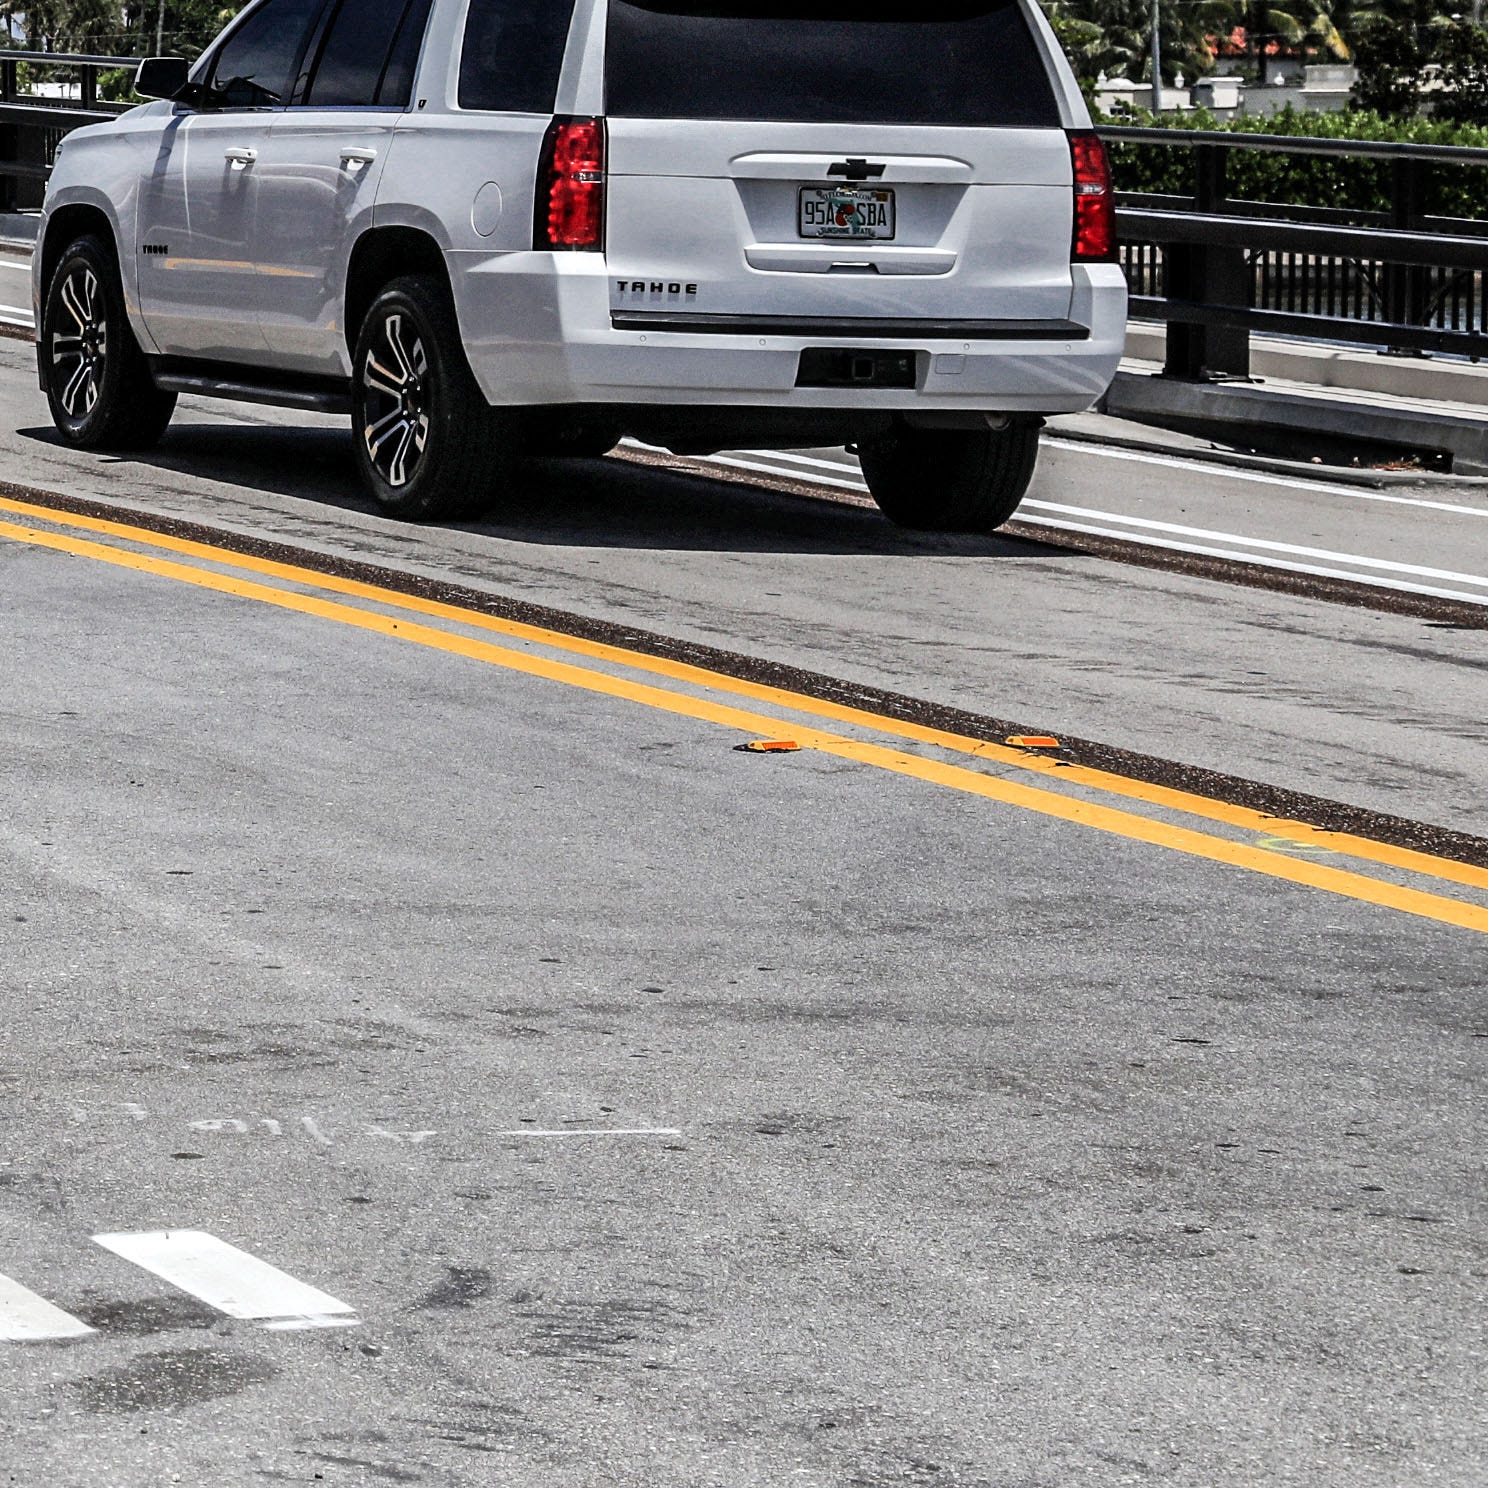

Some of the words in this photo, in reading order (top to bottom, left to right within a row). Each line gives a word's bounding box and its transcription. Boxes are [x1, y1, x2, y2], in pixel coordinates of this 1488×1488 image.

[805, 201, 835, 225] 95A
[856, 203, 887, 227] SBA
[617, 280, 698, 294] TAHOE
